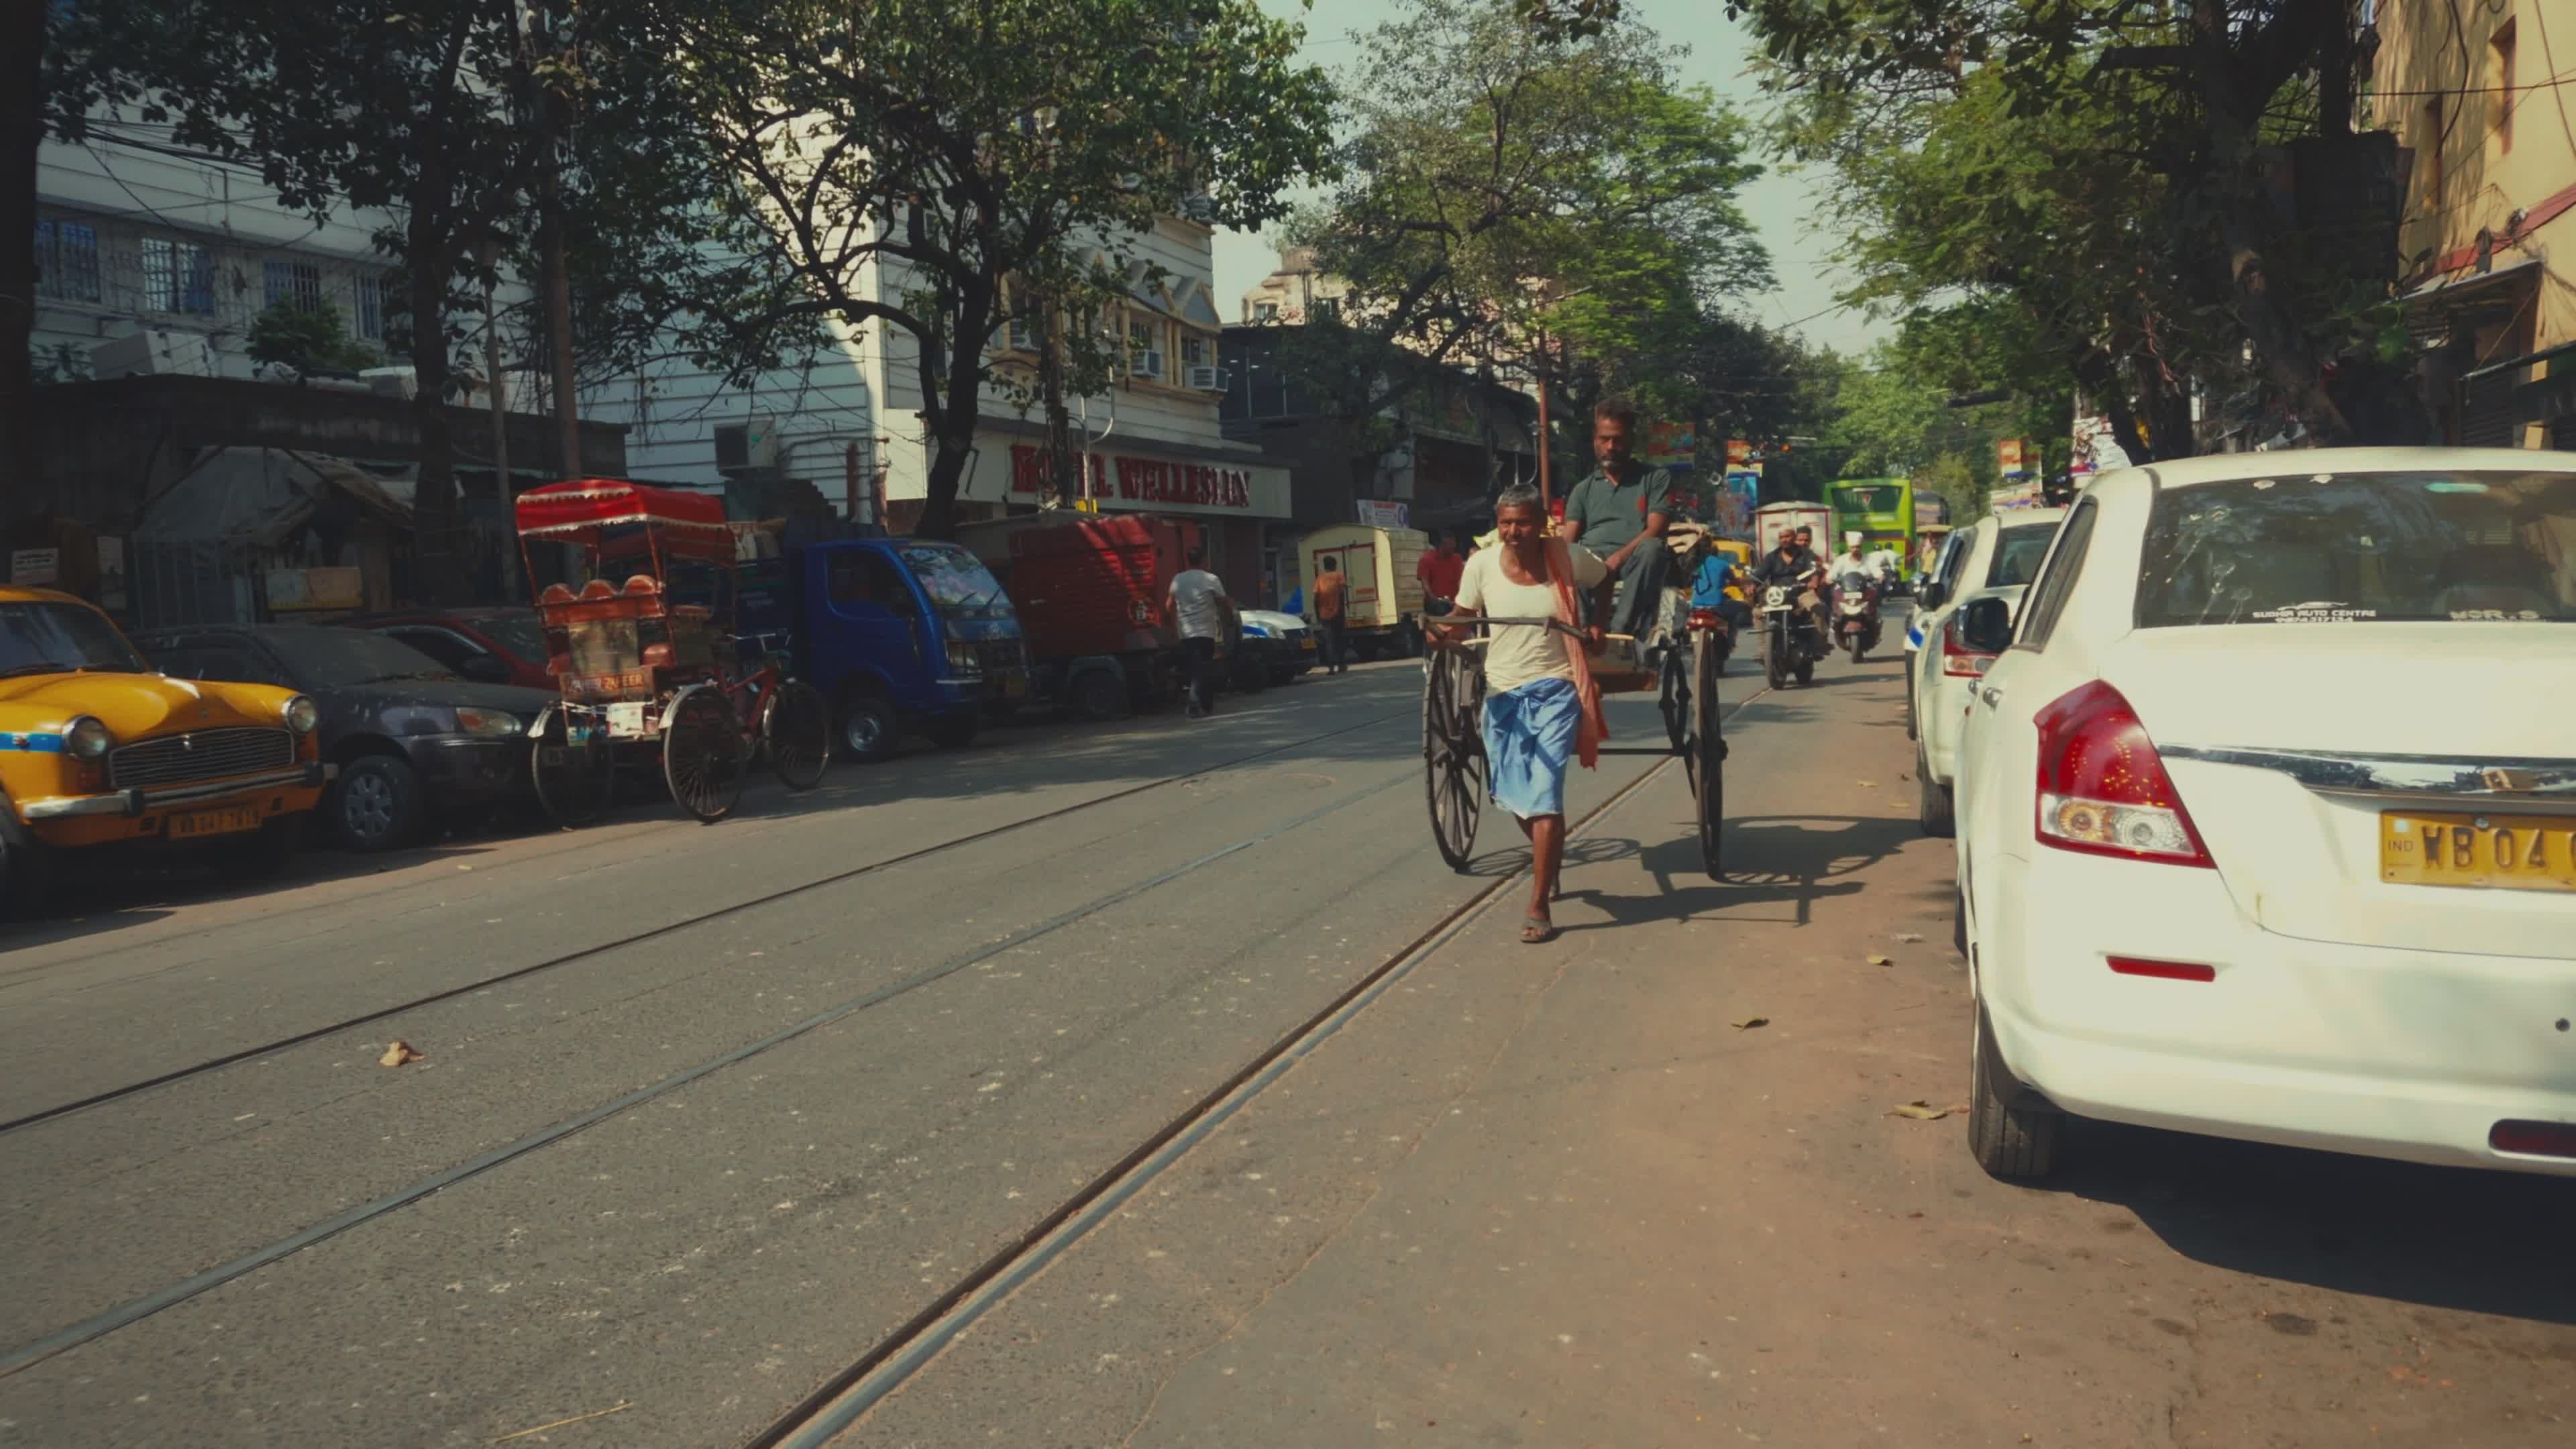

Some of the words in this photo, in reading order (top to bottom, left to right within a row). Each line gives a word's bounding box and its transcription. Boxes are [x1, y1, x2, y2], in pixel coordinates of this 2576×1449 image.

[2298, 609, 2328, 617] AUTO
[2331, 609, 2377, 617] CENTRE
[2387, 839, 2414, 853] IND
